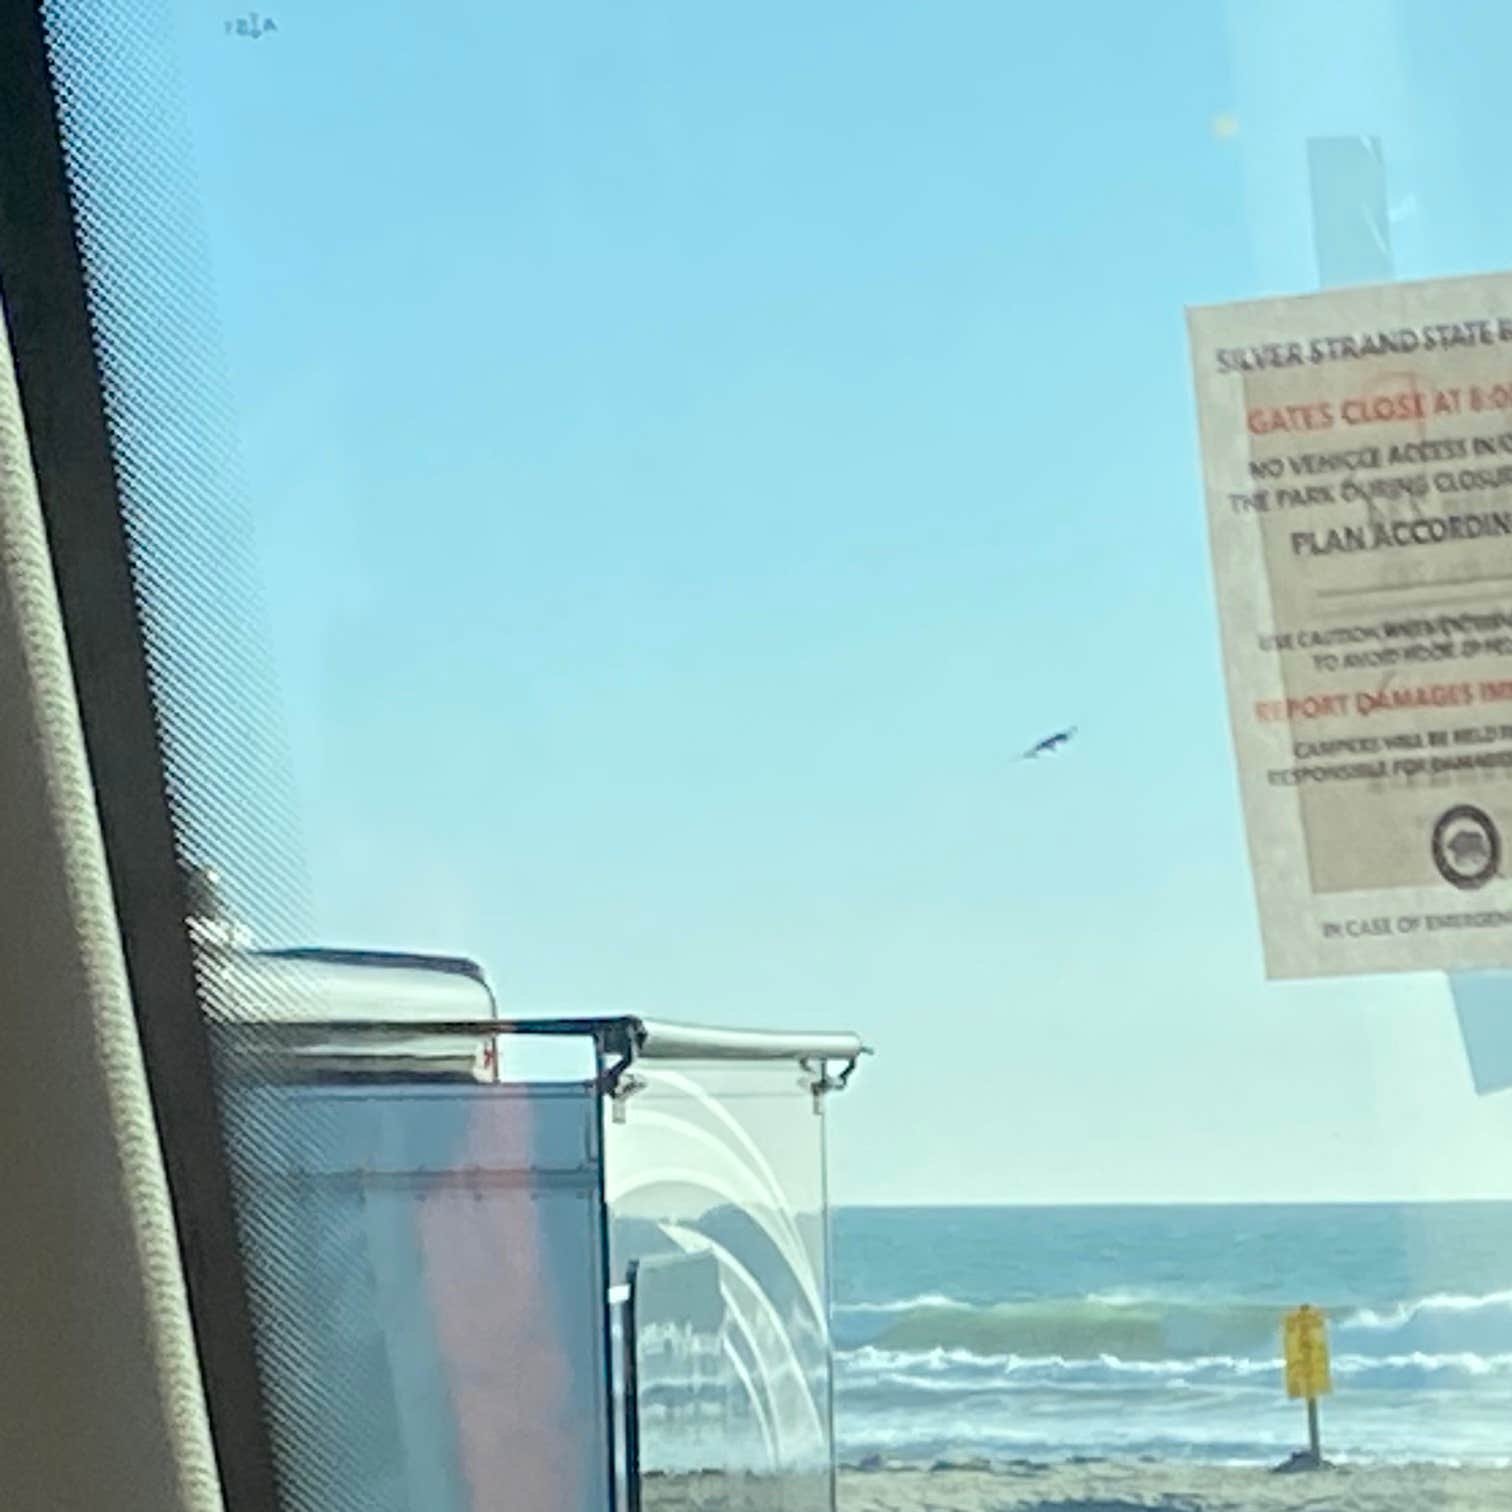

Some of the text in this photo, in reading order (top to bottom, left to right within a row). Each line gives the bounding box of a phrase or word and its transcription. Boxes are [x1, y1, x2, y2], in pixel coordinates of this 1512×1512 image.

[1217, 342, 1304, 373] SILVER
[1310, 327, 1419, 364] STRAND
[1422, 320, 1494, 351] STATE
[1248, 402, 1334, 435] GATES
[1341, 390, 1424, 426] CLOSE
[1434, 387, 1462, 415] AT
[1250, 458, 1285, 479] NO
[1288, 446, 1380, 475] VEHICLE
[1388, 438, 1467, 466] ACCESS
[1229, 489, 1271, 514] THE
[1276, 485, 1336, 508] PARK
[1291, 526, 1366, 555] PLAN
[1256, 694, 1348, 722] REPORT
[1356, 682, 1474, 716] DAMAGES
[1345, 916, 1393, 937] CASE
